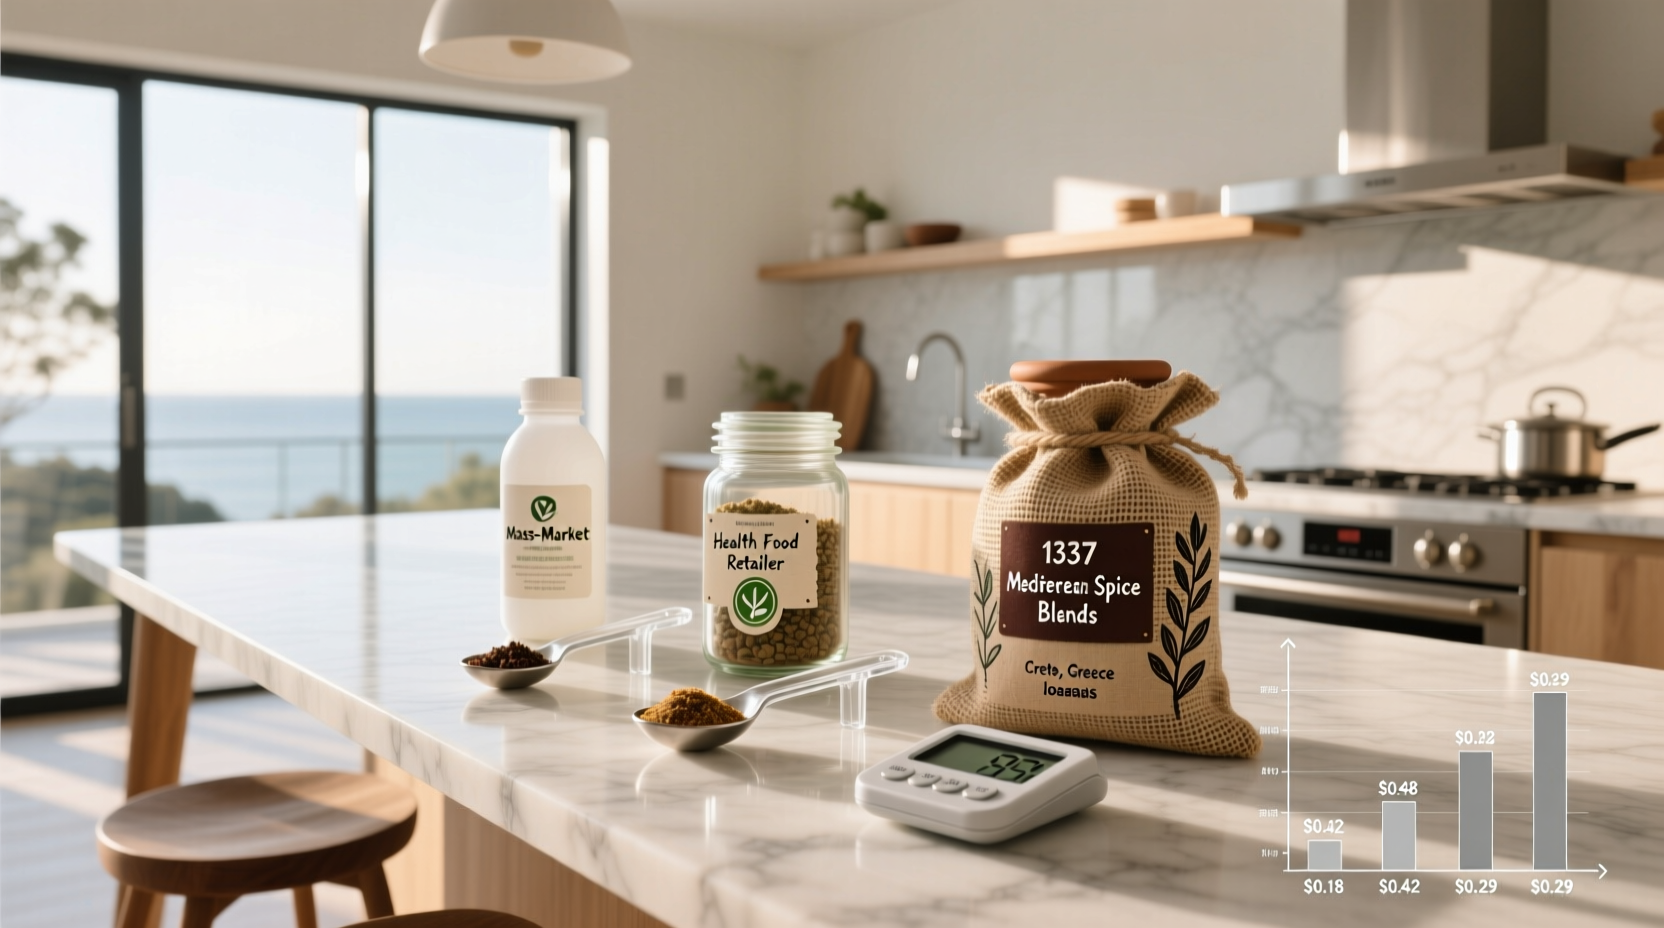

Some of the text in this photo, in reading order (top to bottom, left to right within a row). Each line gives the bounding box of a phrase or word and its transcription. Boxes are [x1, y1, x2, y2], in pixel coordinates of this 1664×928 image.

[506, 525, 590, 542] Mass-Market
[713, 531, 799, 550] Health Food
[1042, 540, 1098, 565] 1337
[727, 554, 785, 571] Retailer
[1094, 574, 1141, 604] Spice
[1038, 600, 1098, 624] Blends
[1067, 663, 1115, 680] Greece
